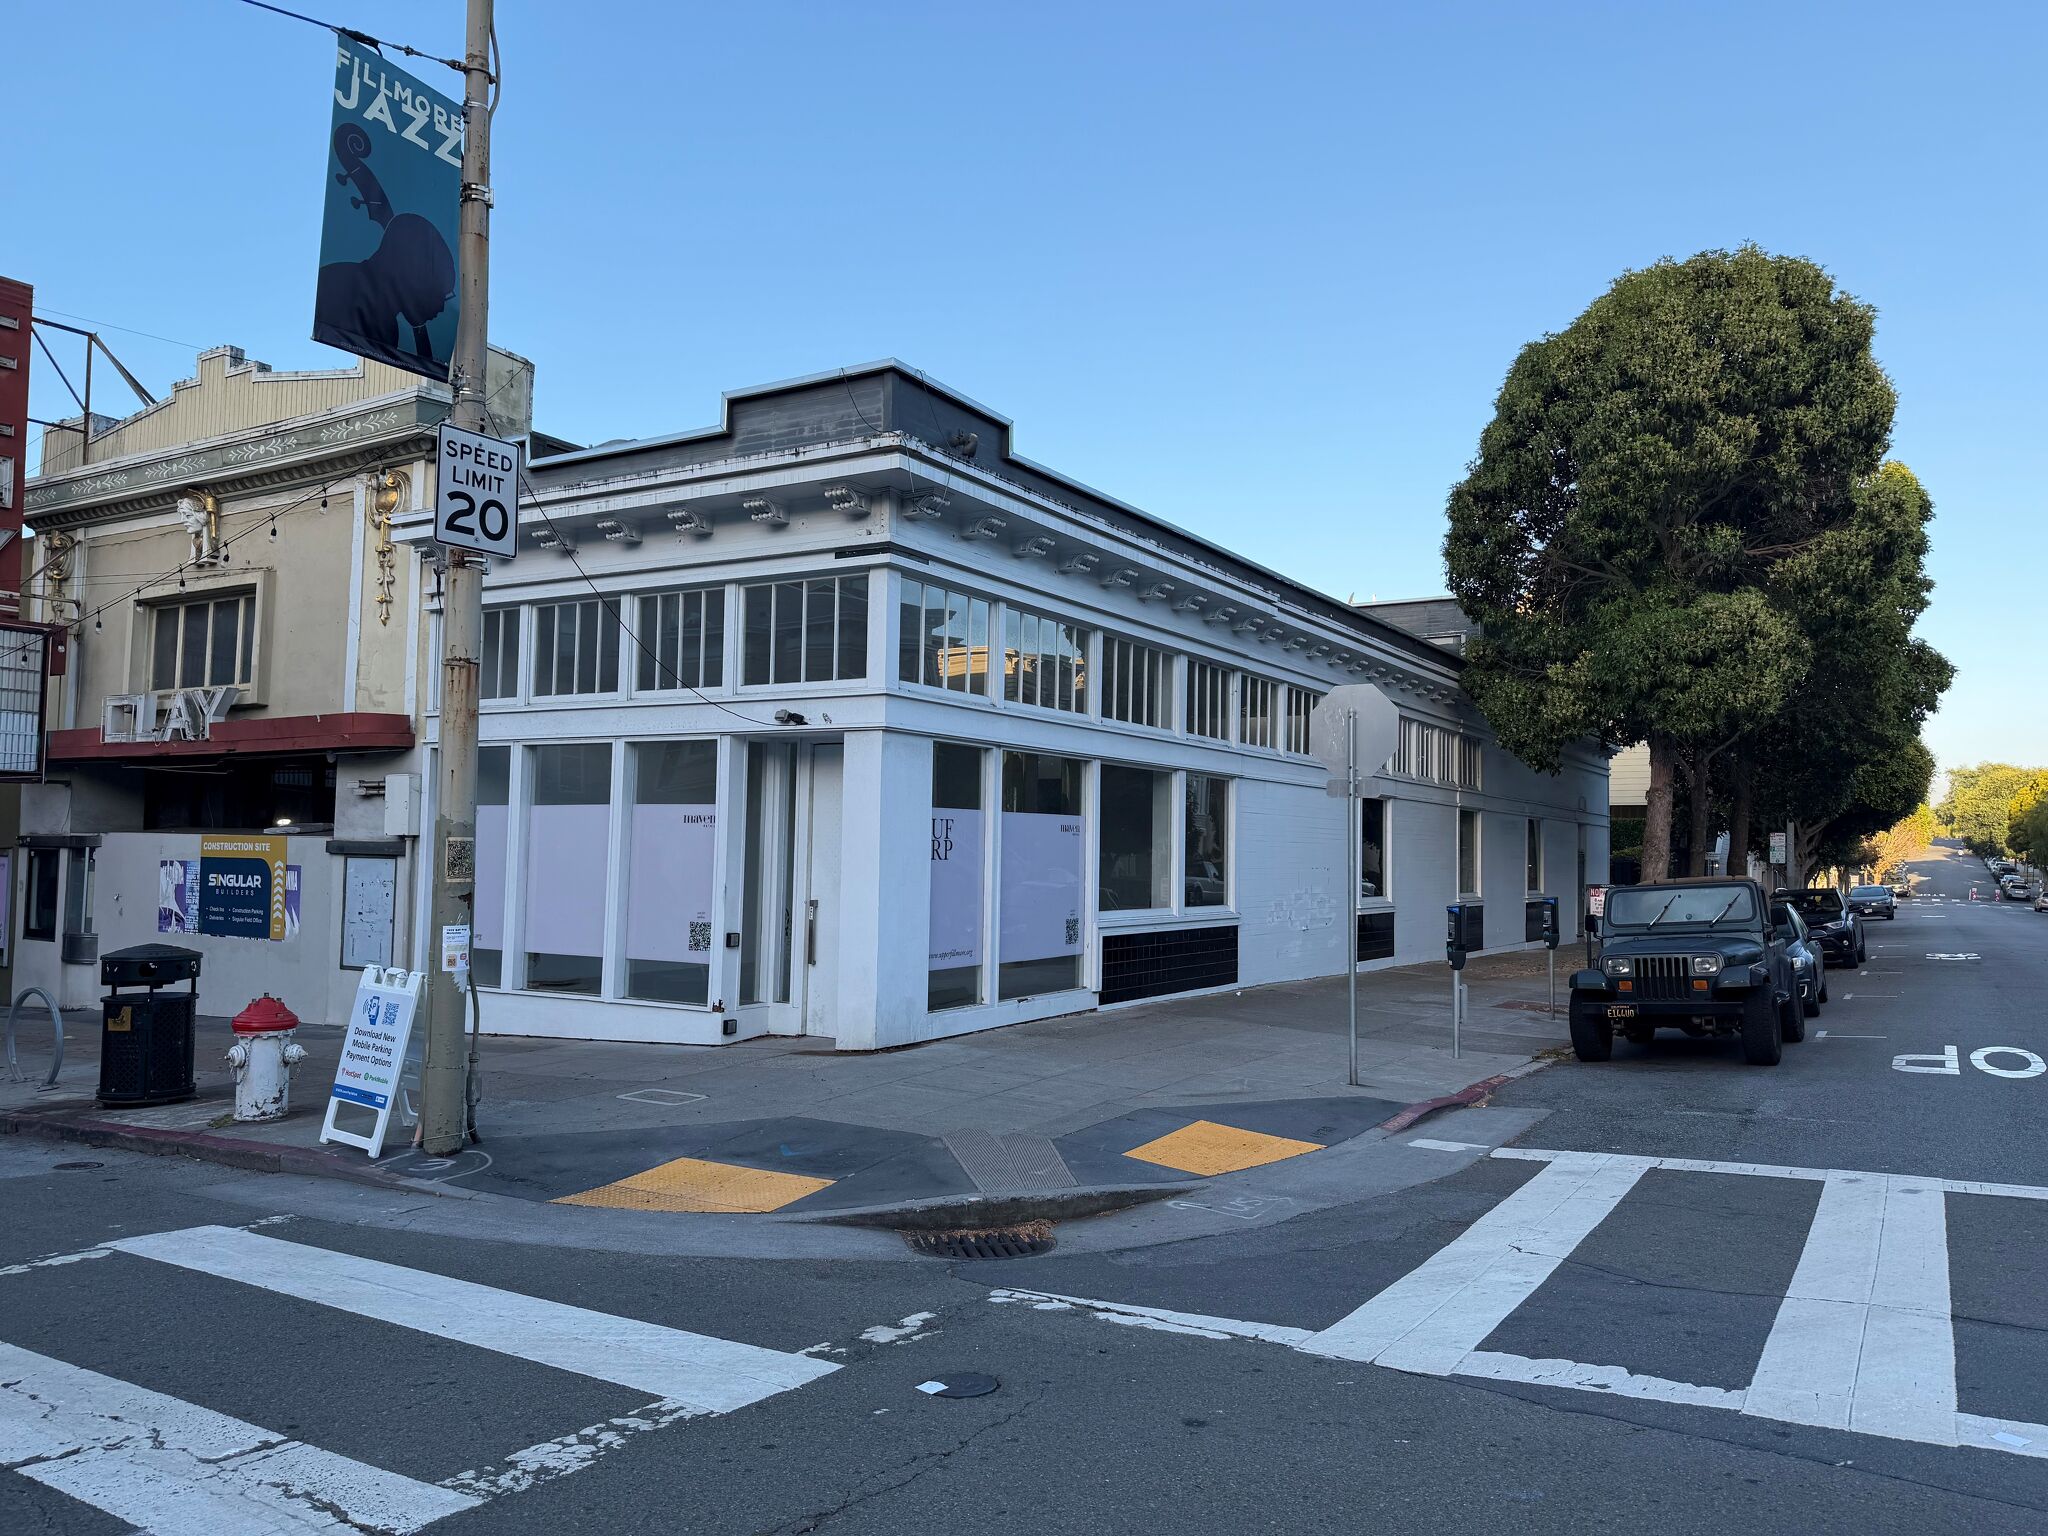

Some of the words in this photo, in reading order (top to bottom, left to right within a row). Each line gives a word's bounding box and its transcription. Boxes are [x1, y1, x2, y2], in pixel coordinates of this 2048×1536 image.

[336, 47, 462, 132] FILLMORE
[335, 73, 462, 168] JAZZ
[445, 440, 513, 472] SPEED
[452, 465, 505, 494] LIMIT
[445, 491, 509, 541] 20
[931, 818, 954, 839] UF
[203, 841, 253, 851] CONSTRUCTION
[254, 842, 271, 852] SITE
[208, 873, 262, 888] SINGULAR
[215, 888, 255, 896] BUILDERS
[354, 1026, 383, 1040] Download
[382, 1032, 397, 1043] New
[352, 1039, 371, 1050] Mobile
[371, 1043, 393, 1057] Parking
[346, 1049, 370, 1062] Payment
[370, 1055, 392, 1068] Options
